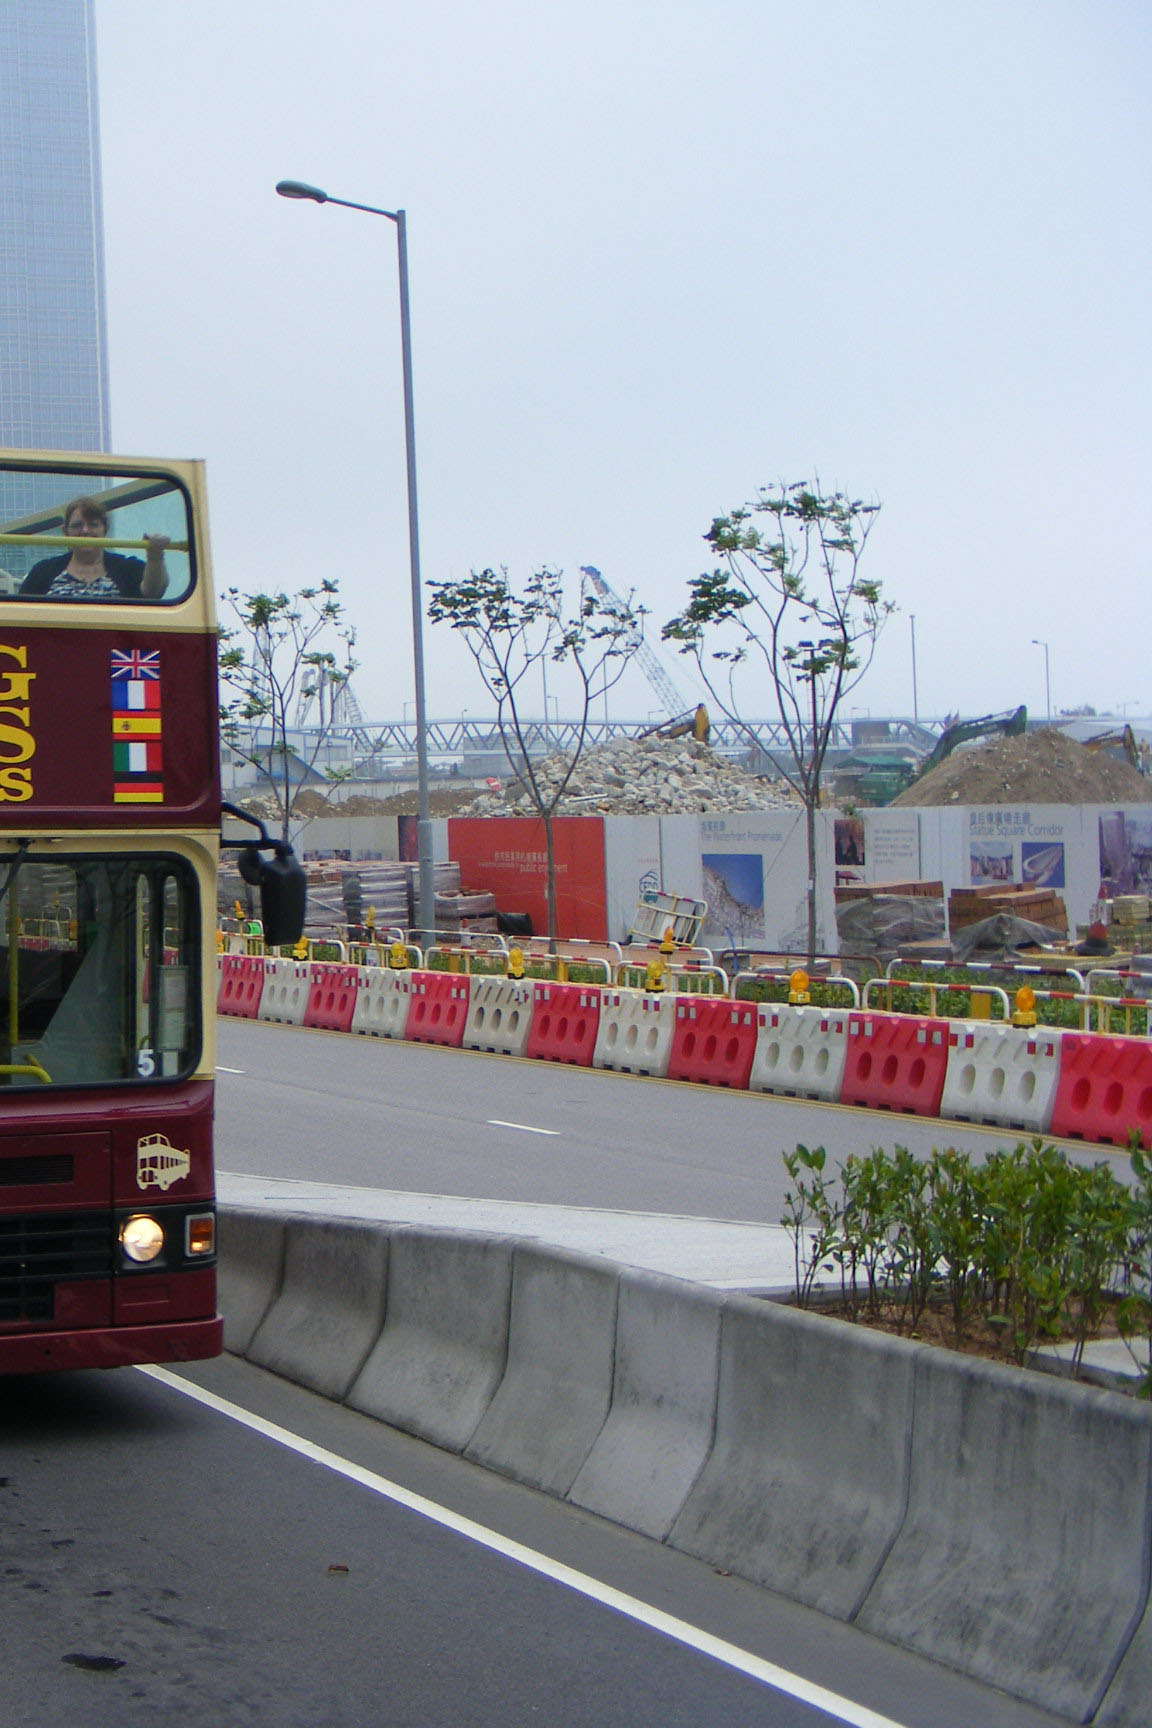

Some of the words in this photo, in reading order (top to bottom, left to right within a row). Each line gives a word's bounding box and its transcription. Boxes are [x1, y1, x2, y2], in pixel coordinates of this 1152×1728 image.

[969, 823, 994, 836] Statue
[996, 823, 1025, 838] Square
[1027, 823, 1065, 836] Corridor
[137, 1048, 155, 1077] 5
